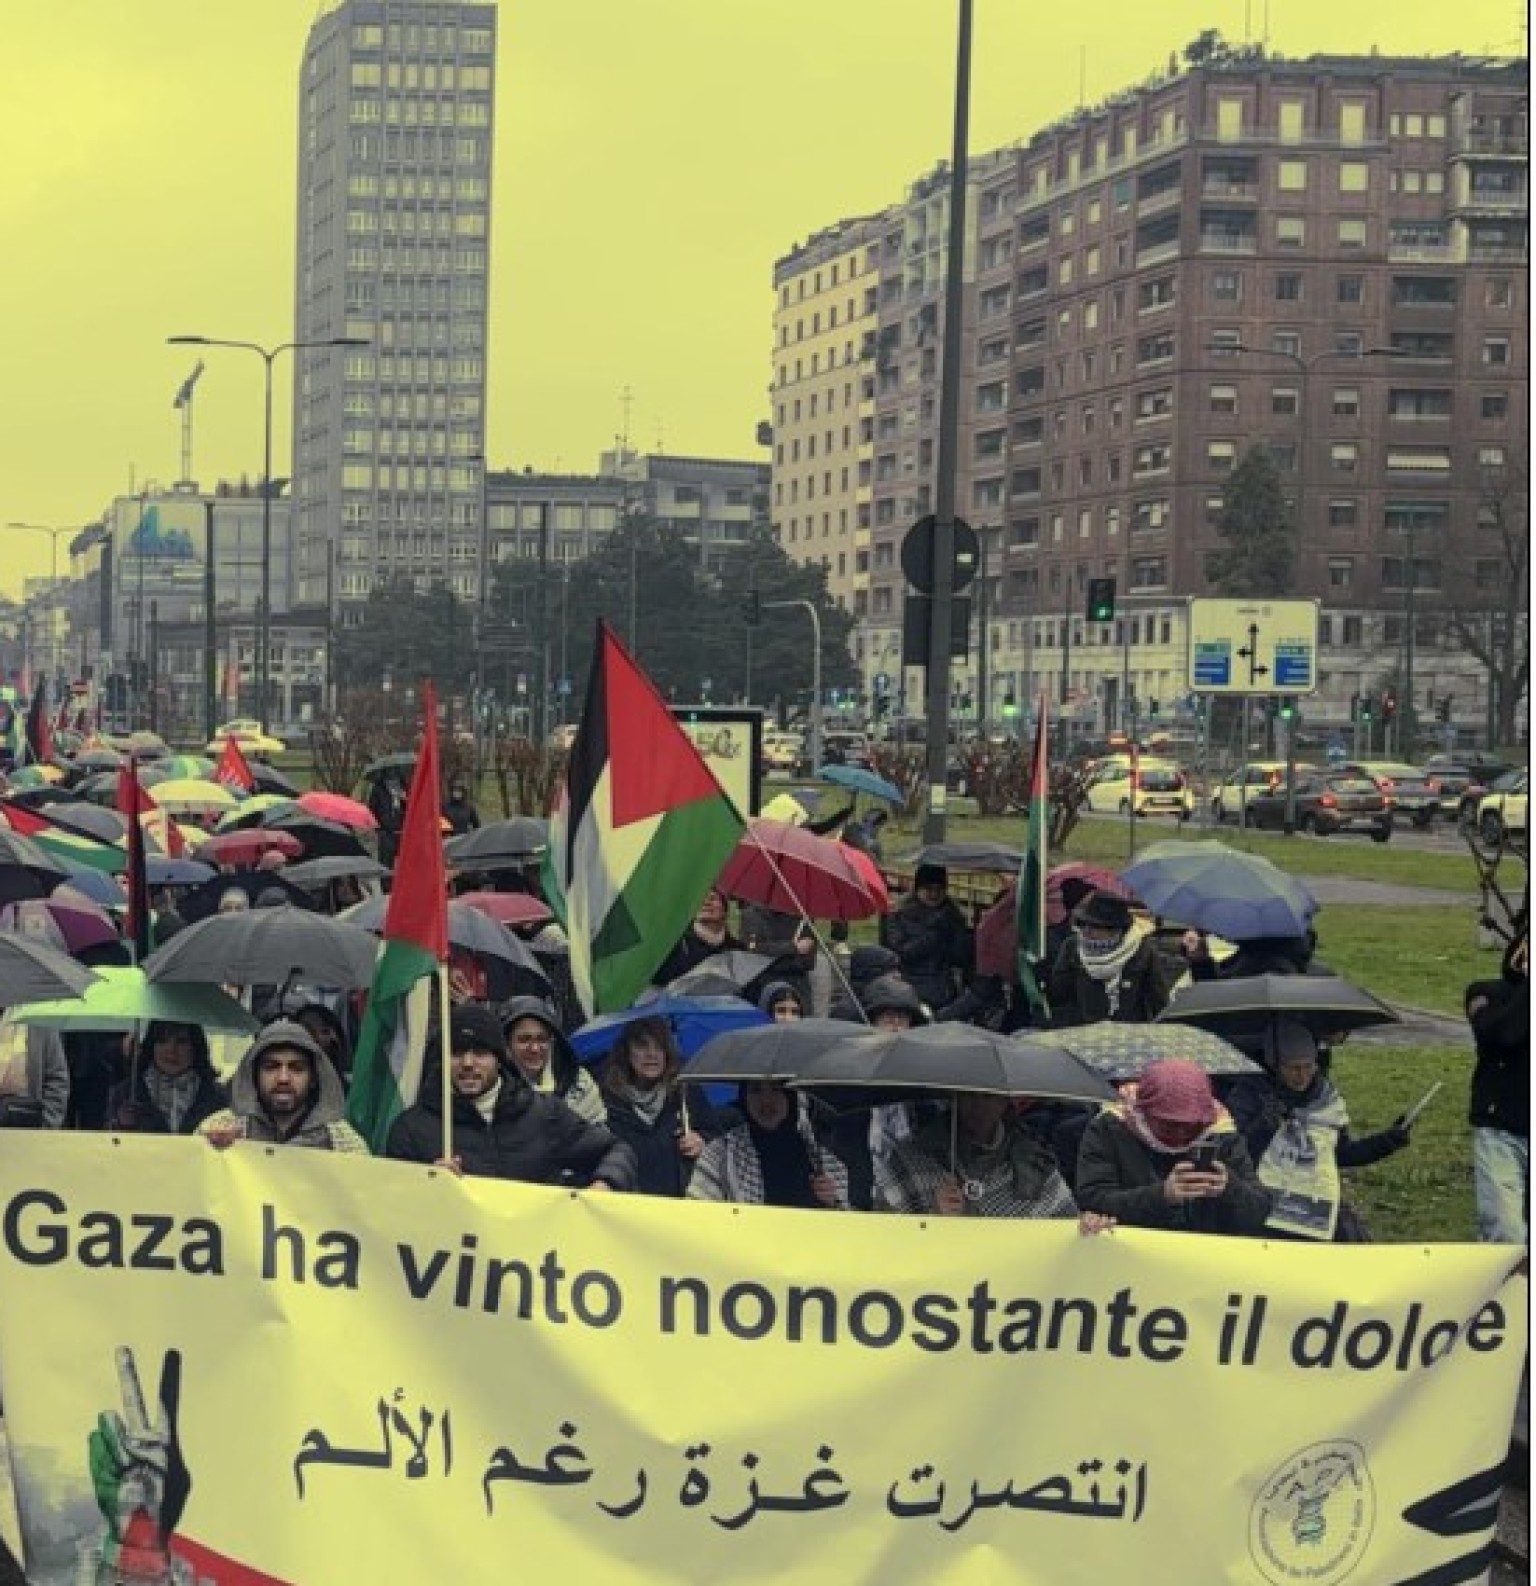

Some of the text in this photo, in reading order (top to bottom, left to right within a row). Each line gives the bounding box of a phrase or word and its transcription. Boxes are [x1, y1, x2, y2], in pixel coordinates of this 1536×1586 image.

[3, 1189, 225, 1276] Gaza
[262, 1204, 361, 1290] ha
[398, 1233, 622, 1328] vinto
[659, 1276, 1189, 1362] nonostante
[1218, 1292, 1268, 1367] il
[294, 1387, 452, 1500] الألم
[483, 1421, 648, 1517] رغم
[678, 1443, 851, 1531] غزة
[886, 1458, 1148, 1532] انتصرت
